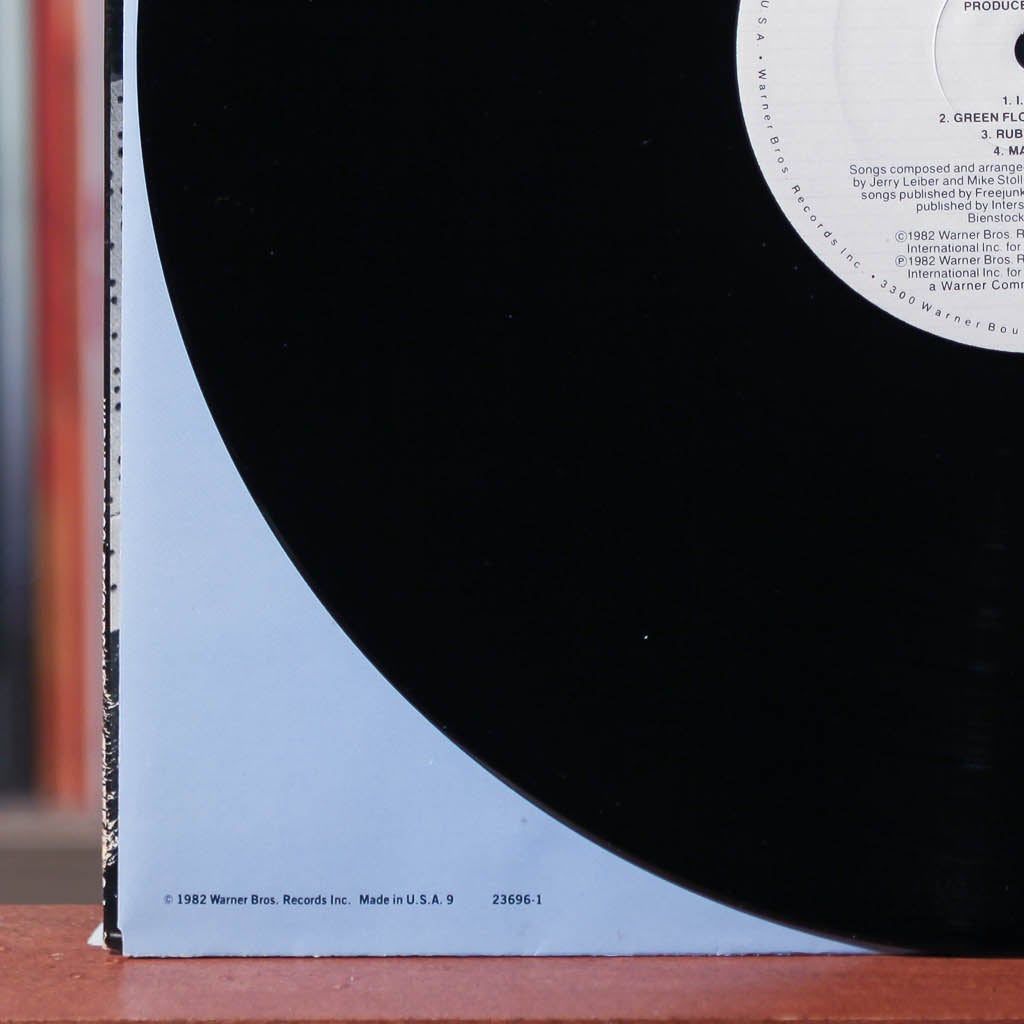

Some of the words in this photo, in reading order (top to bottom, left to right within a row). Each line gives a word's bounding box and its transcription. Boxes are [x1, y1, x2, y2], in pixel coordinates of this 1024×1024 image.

[1002, 95, 1011, 105] 1.
[939, 113, 949, 123] 2.
[953, 112, 998, 123] GREEN
[981, 129, 991, 139] 3.
[993, 145, 1003, 156] 4.
[849, 163, 886, 177] Songs
[889, 162, 950, 176] composed
[953, 162, 974, 173] and
[916, 200, 971, 213] published
[975, 199, 988, 213] by
[967, 212, 1024, 223] Bienstock
[907, 242, 978, 253] International
[1006, 241, 1021, 252] for
[928, 283, 936, 291] a
[940, 280, 986, 291] Warner
[880, 279, 916, 305] 3300
[921, 301, 981, 329] Warner
[178, 894, 206, 904] 1982
[209, 894, 248, 904] Warner
[251, 894, 278, 905] Bros.
[283, 894, 327, 905] Records
[330, 894, 351, 905] Inc.
[359, 894, 389, 904] Made
[392, 894, 403, 904] in
[406, 894, 442, 904] U.S.A.
[446, 894, 453, 905] 9
